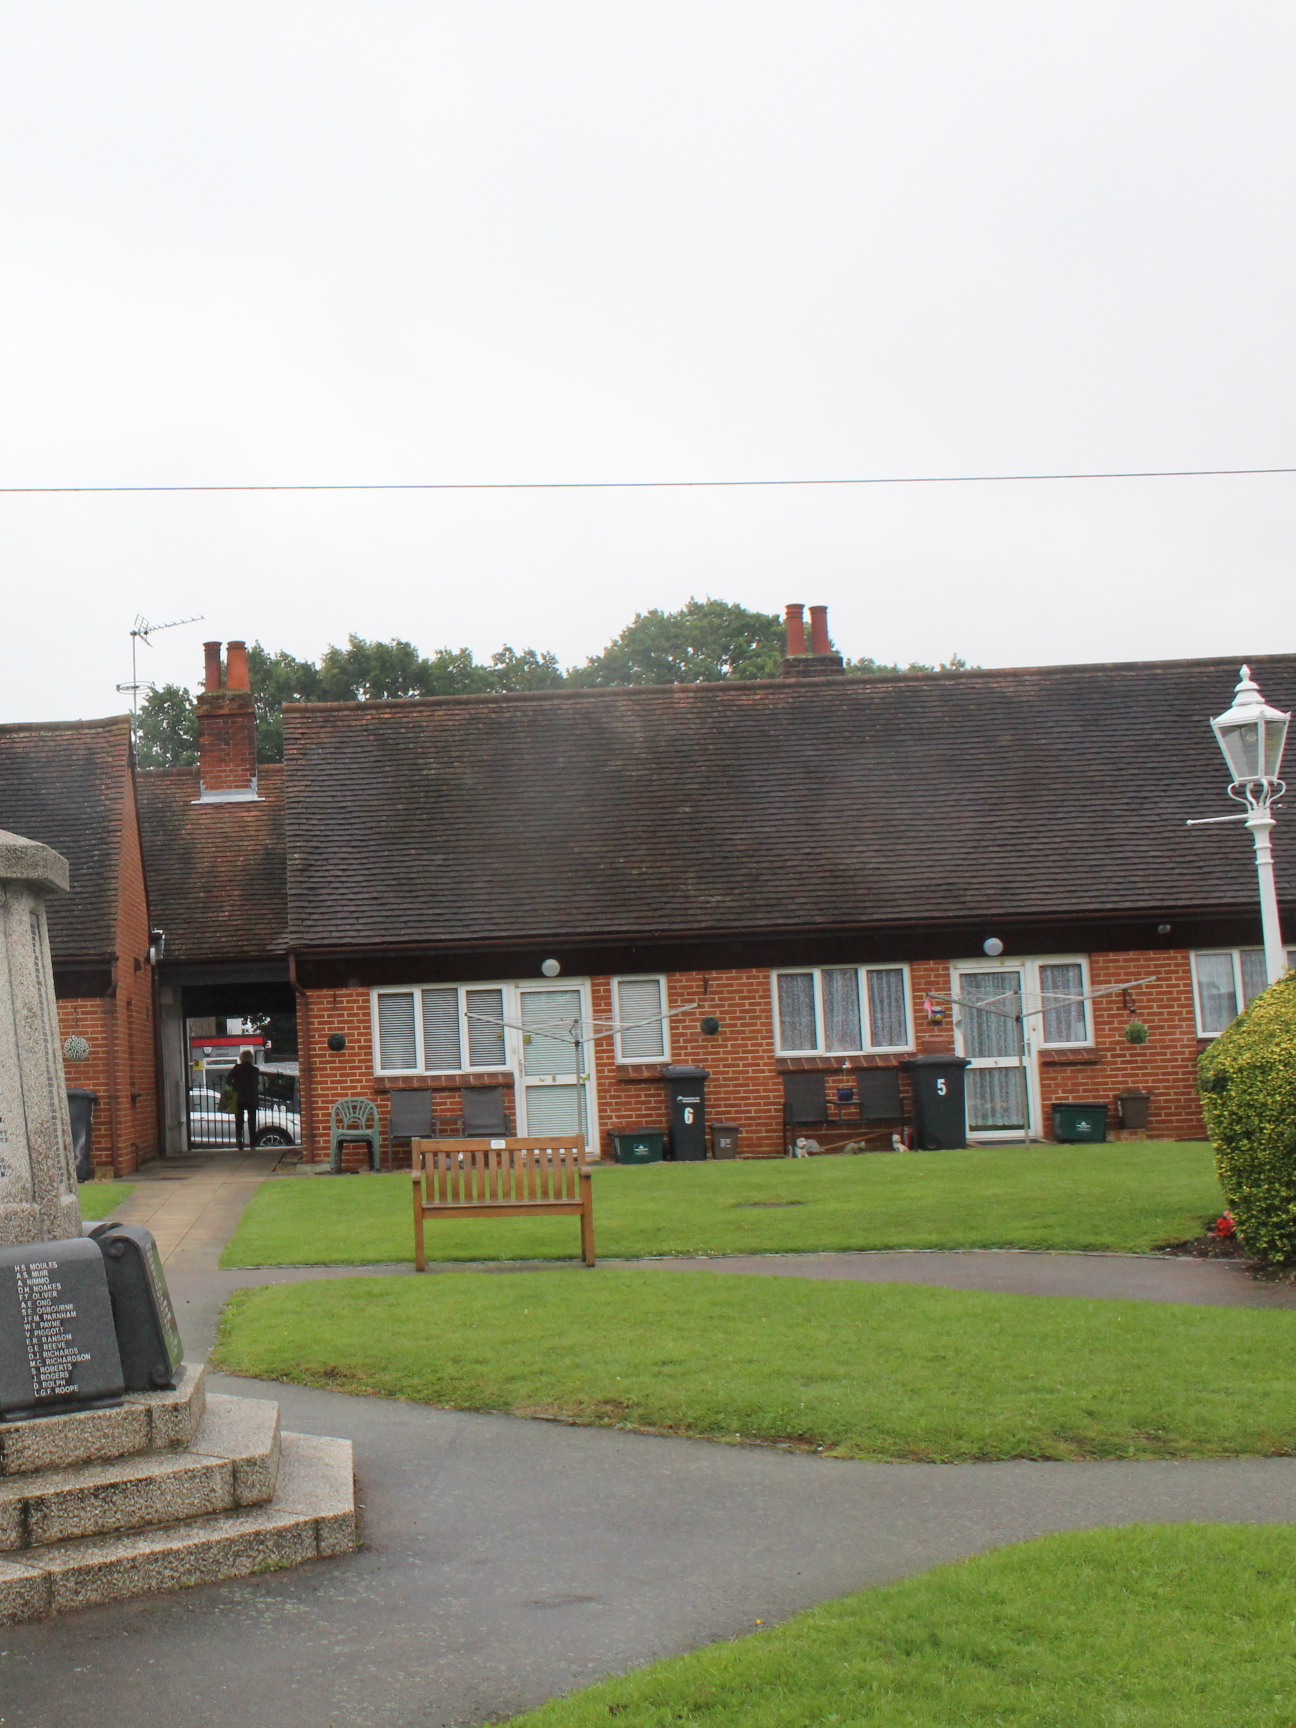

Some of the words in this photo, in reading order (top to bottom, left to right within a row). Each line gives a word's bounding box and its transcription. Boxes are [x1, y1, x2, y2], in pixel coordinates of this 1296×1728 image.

[937, 1078, 947, 1096] 5
[684, 1107, 694, 1124] 6
[29, 1261, 58, 1271] MOULES
[31, 1270, 49, 1278] MUIR
[26, 1277, 49, 1285] NIMMO
[33, 1283, 62, 1292] NOAKES
[32, 1291, 58, 1300] OLIVER
[37, 1304, 74, 1314] OSBOURNE
[43, 1311, 77, 1321] PARNHAM
[40, 1320, 61, 1328] PAYNE
[34, 1327, 64, 1337] PIGGOTT
[42, 1333, 72, 1343] RANSOM
[43, 1342, 66, 1351] REEVE
[43, 1347, 79, 1358] RICHARDS
[46, 1353, 91, 1365] RICHARDSON
[40, 1363, 72, 1374] ROBERTS
[40, 1371, 69, 1381] ROGERS
[42, 1379, 66, 1388] ROLPH
[55, 1384, 79, 1394] ROOPE
